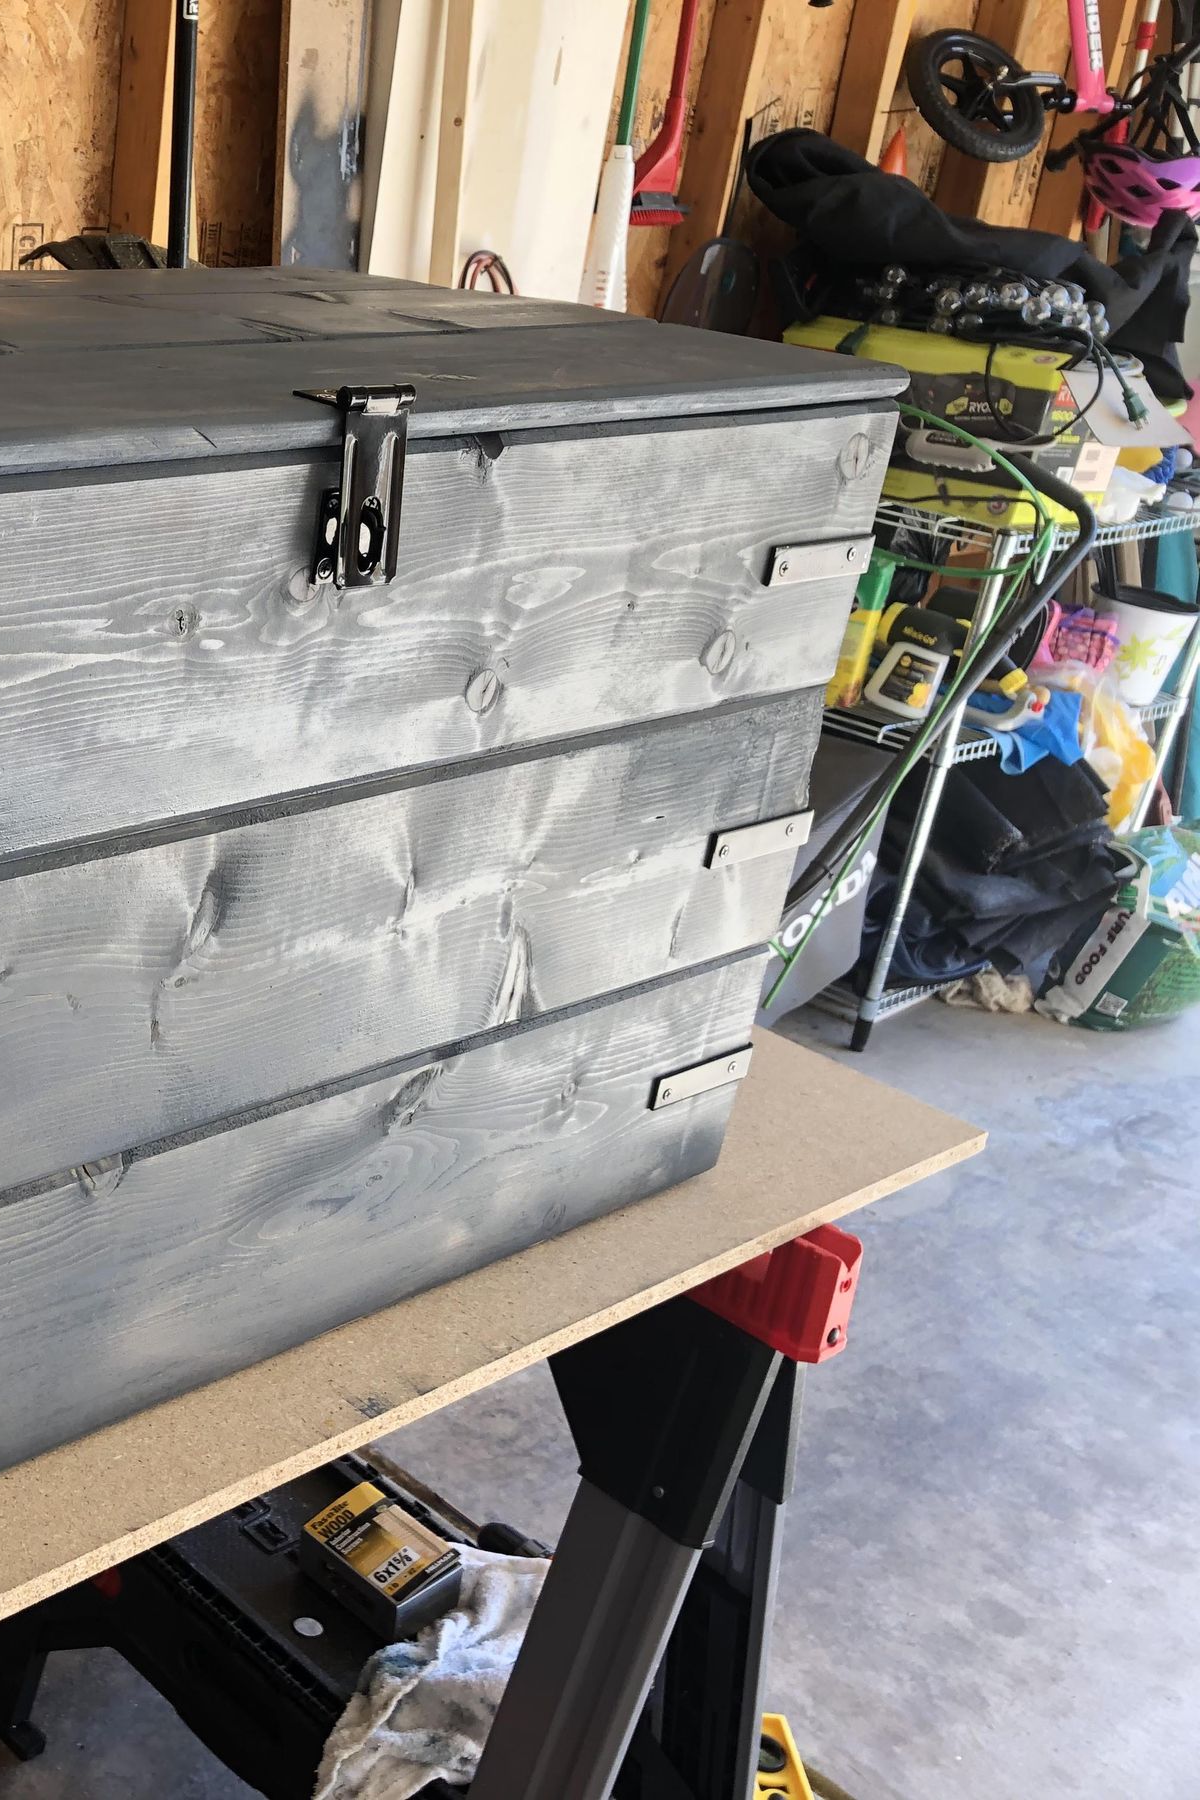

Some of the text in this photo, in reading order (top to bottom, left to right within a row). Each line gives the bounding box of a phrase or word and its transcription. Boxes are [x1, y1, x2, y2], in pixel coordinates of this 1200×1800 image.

[1075, 911, 1134, 985] URF FOOD
[318, 1509, 354, 1538] WOOD
